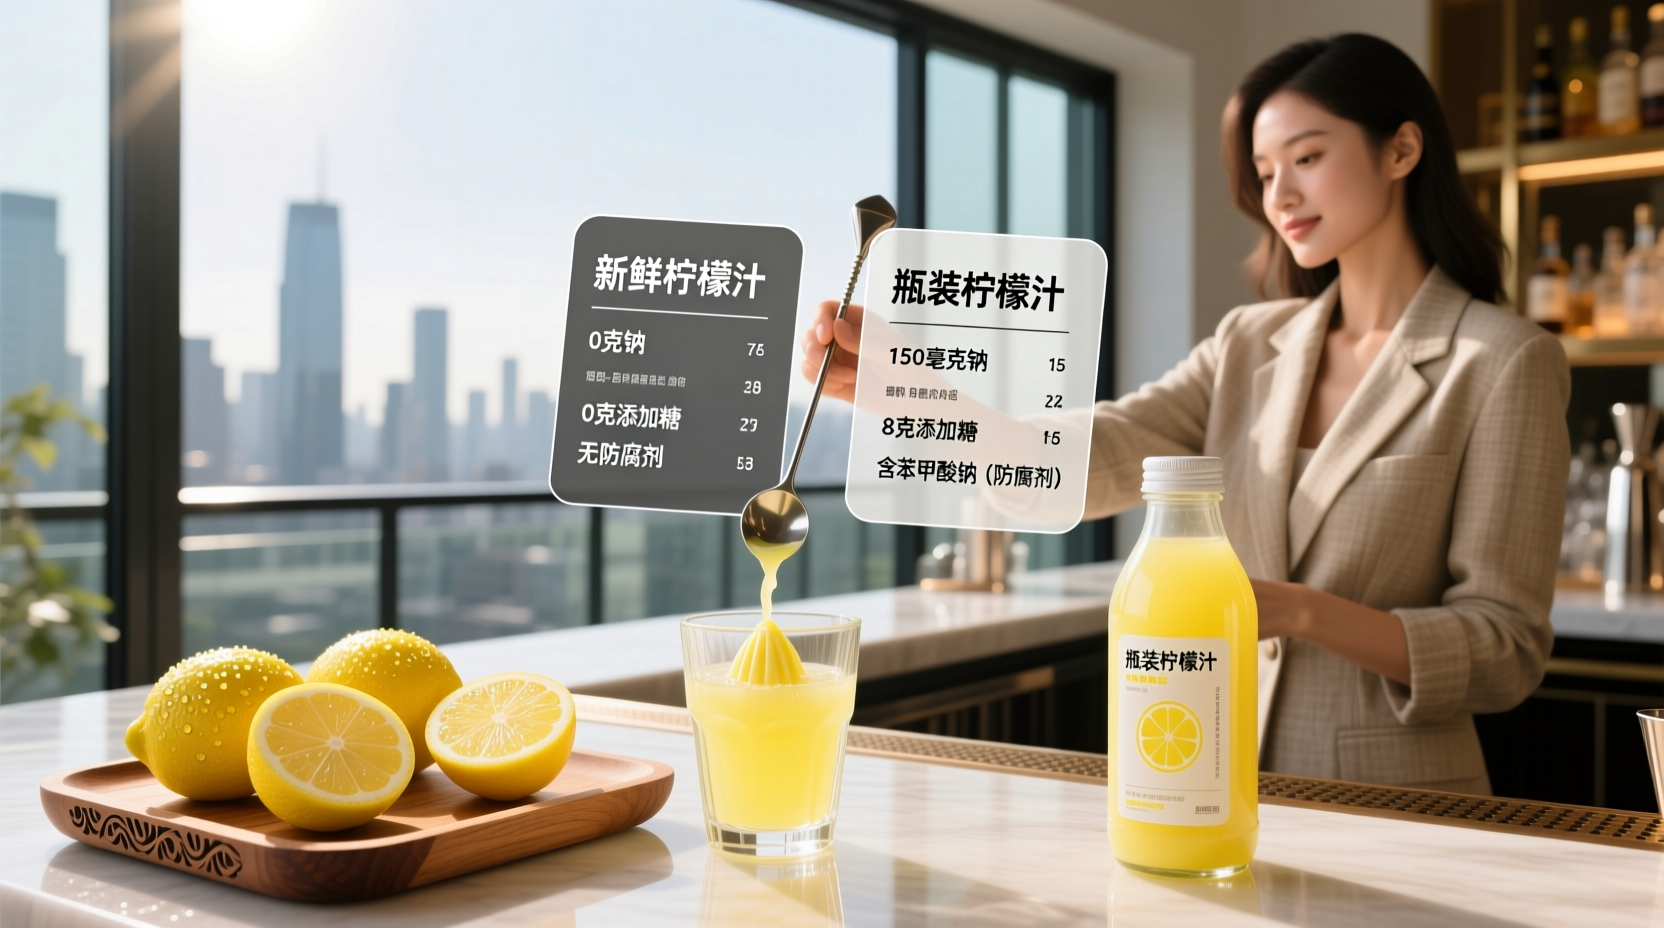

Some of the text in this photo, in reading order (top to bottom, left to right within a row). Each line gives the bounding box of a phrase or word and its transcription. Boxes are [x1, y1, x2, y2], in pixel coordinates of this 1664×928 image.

[593, 253, 766, 299] 新鲜柠檬汁
[891, 268, 1064, 312] 瓶装柠檬汁
[588, 329, 646, 355] 0克钠
[889, 347, 988, 372] 150毫克钠
[1049, 357, 1066, 372] 15
[1044, 394, 1063, 409] 22
[581, 402, 682, 431] 0克添加糖
[881, 416, 978, 443] 8克添加糖
[577, 441, 664, 469] 无防腐剂
